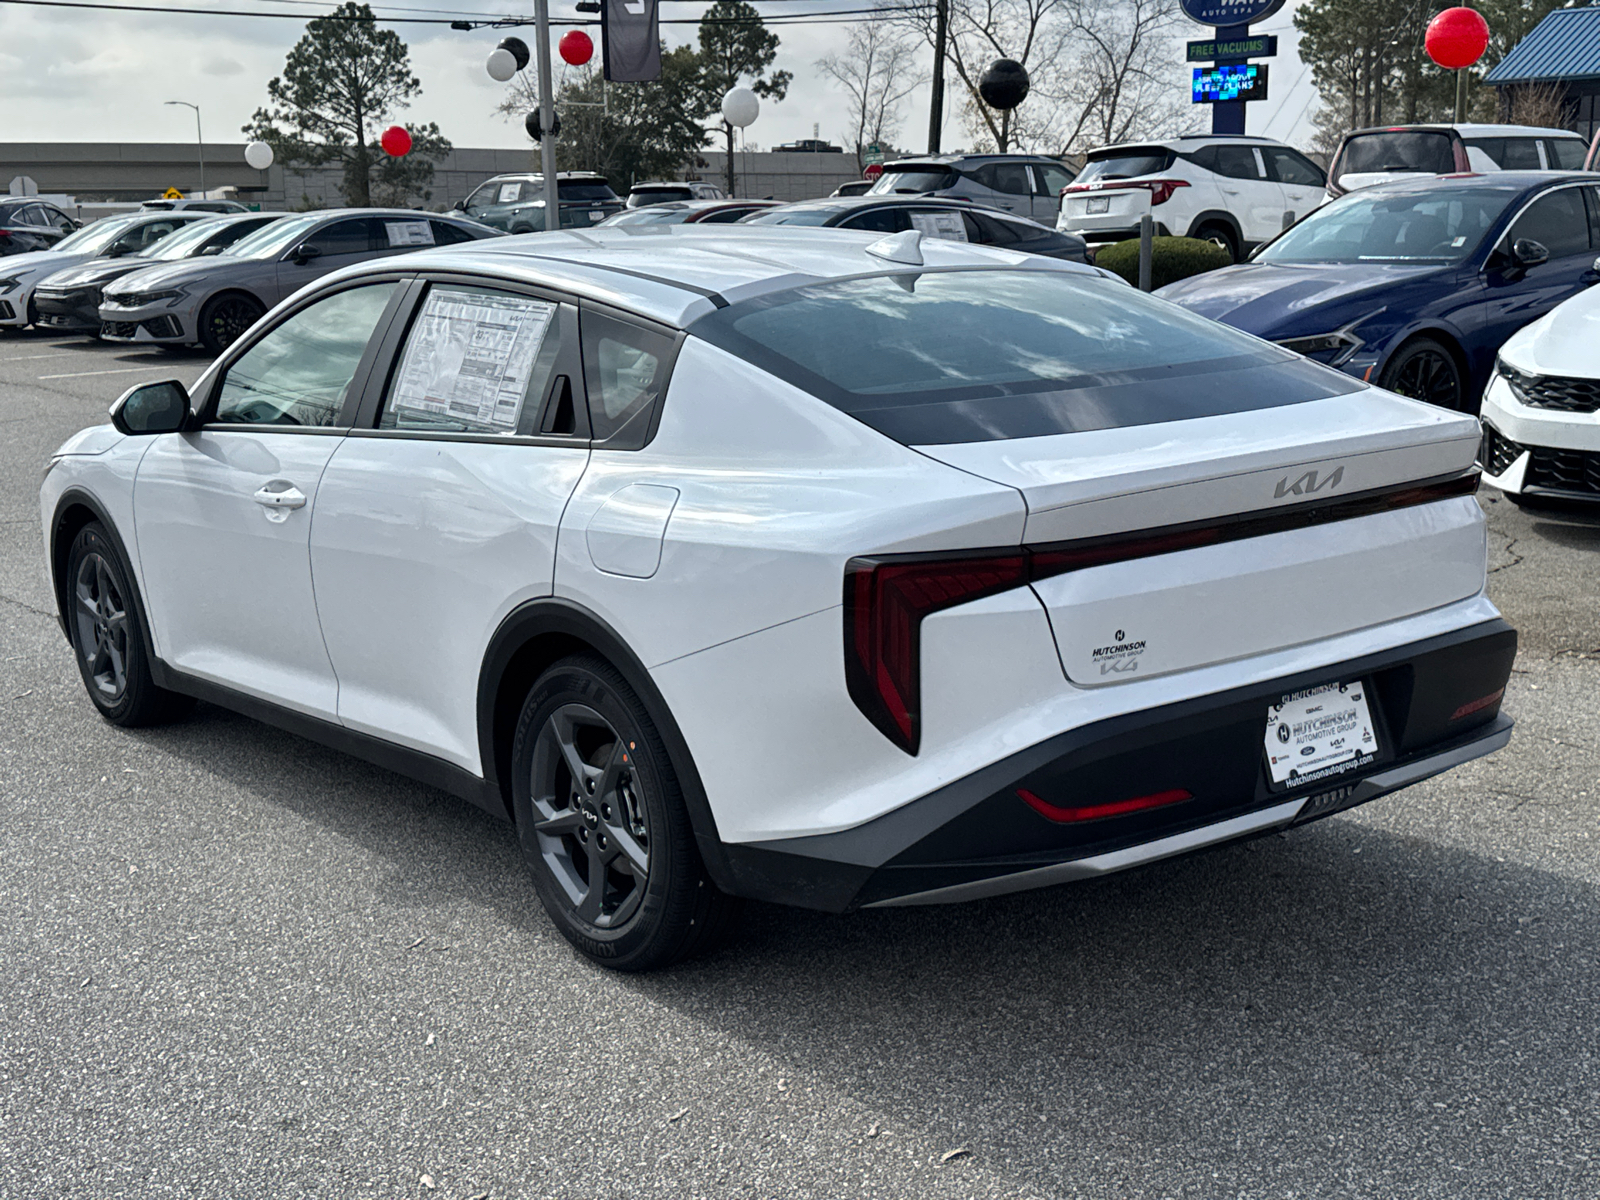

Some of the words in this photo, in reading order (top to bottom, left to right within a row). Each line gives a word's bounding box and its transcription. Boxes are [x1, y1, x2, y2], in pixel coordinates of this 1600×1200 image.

[1202, 9, 1226, 17] AUTO
[1190, 44, 1214, 57] FREE
[1217, 40, 1264, 54] VACUUMS
[865, 172, 881, 181] STO
[1274, 466, 1344, 499] KIA
[1092, 640, 1146, 657] HUTCHINSON
[1092, 653, 1126, 663] AUTOMOTIVE
[1127, 649, 1144, 657] GROUP
[1100, 657, 1138, 676] K4
[1292, 708, 1358, 737] HUTCHINSON
[1296, 727, 1336, 745] AUTOMOTIVE
[1337, 721, 1357, 733] GROUP
[1285, 754, 1374, 788] Hutchinsonautogroup.com
